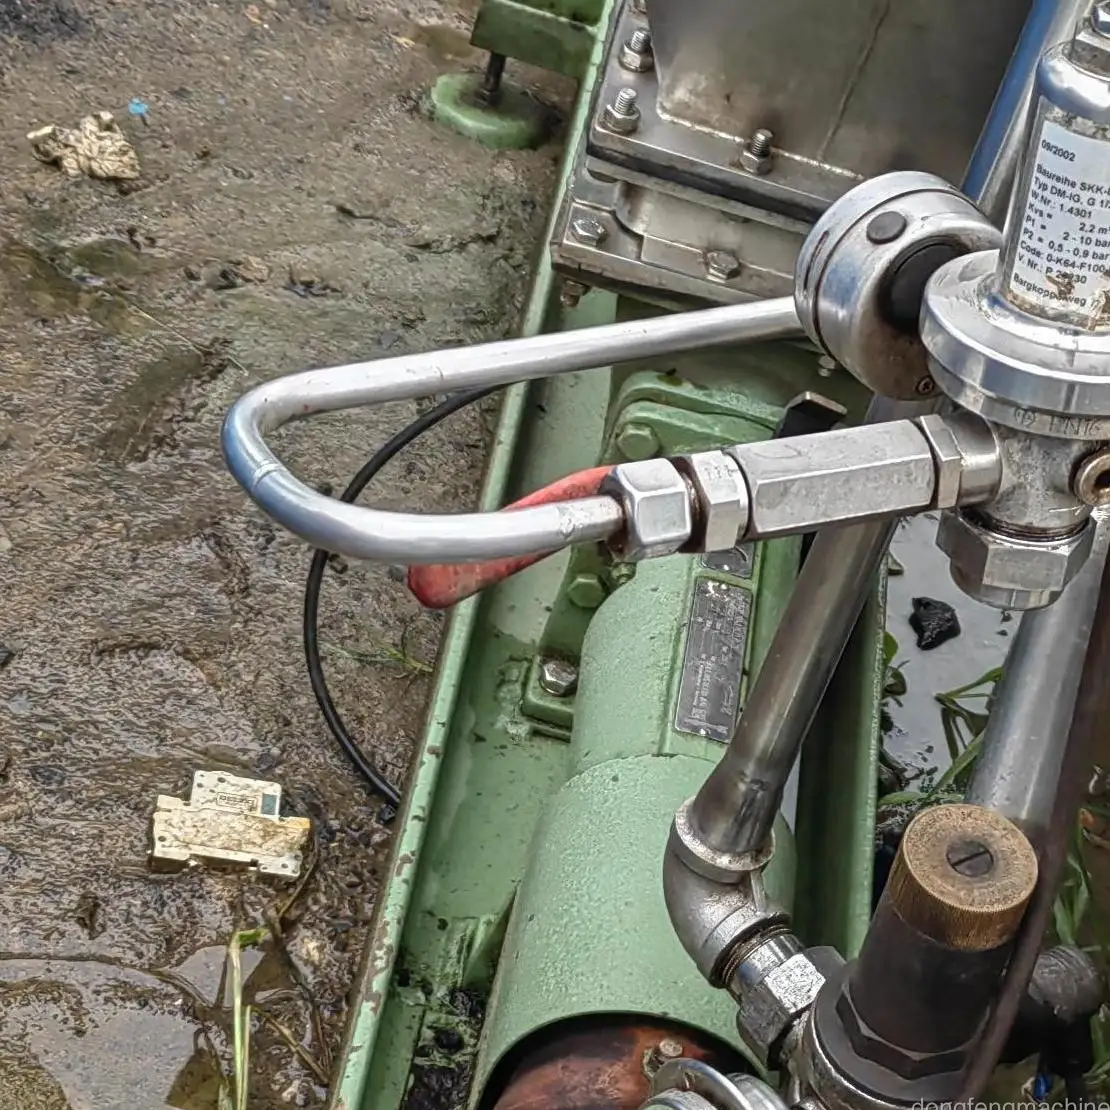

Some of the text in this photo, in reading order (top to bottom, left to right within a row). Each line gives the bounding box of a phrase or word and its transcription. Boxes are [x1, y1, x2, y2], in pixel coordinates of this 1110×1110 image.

[1041, 139, 1076, 161] 09/2002
[1036, 163, 1077, 188] Baureihe
[1034, 175, 1048, 192] Typ
[1087, 197, 1096, 207] G
[1028, 202, 1044, 217] Kvs
[1060, 203, 1093, 219] 1.4301
[1023, 227, 1034, 240] P2
[1092, 251, 1110, 261] bar
[1062, 231, 1070, 241] 2
[1079, 236, 1092, 246] 10
[1020, 240, 1044, 258] Code:
